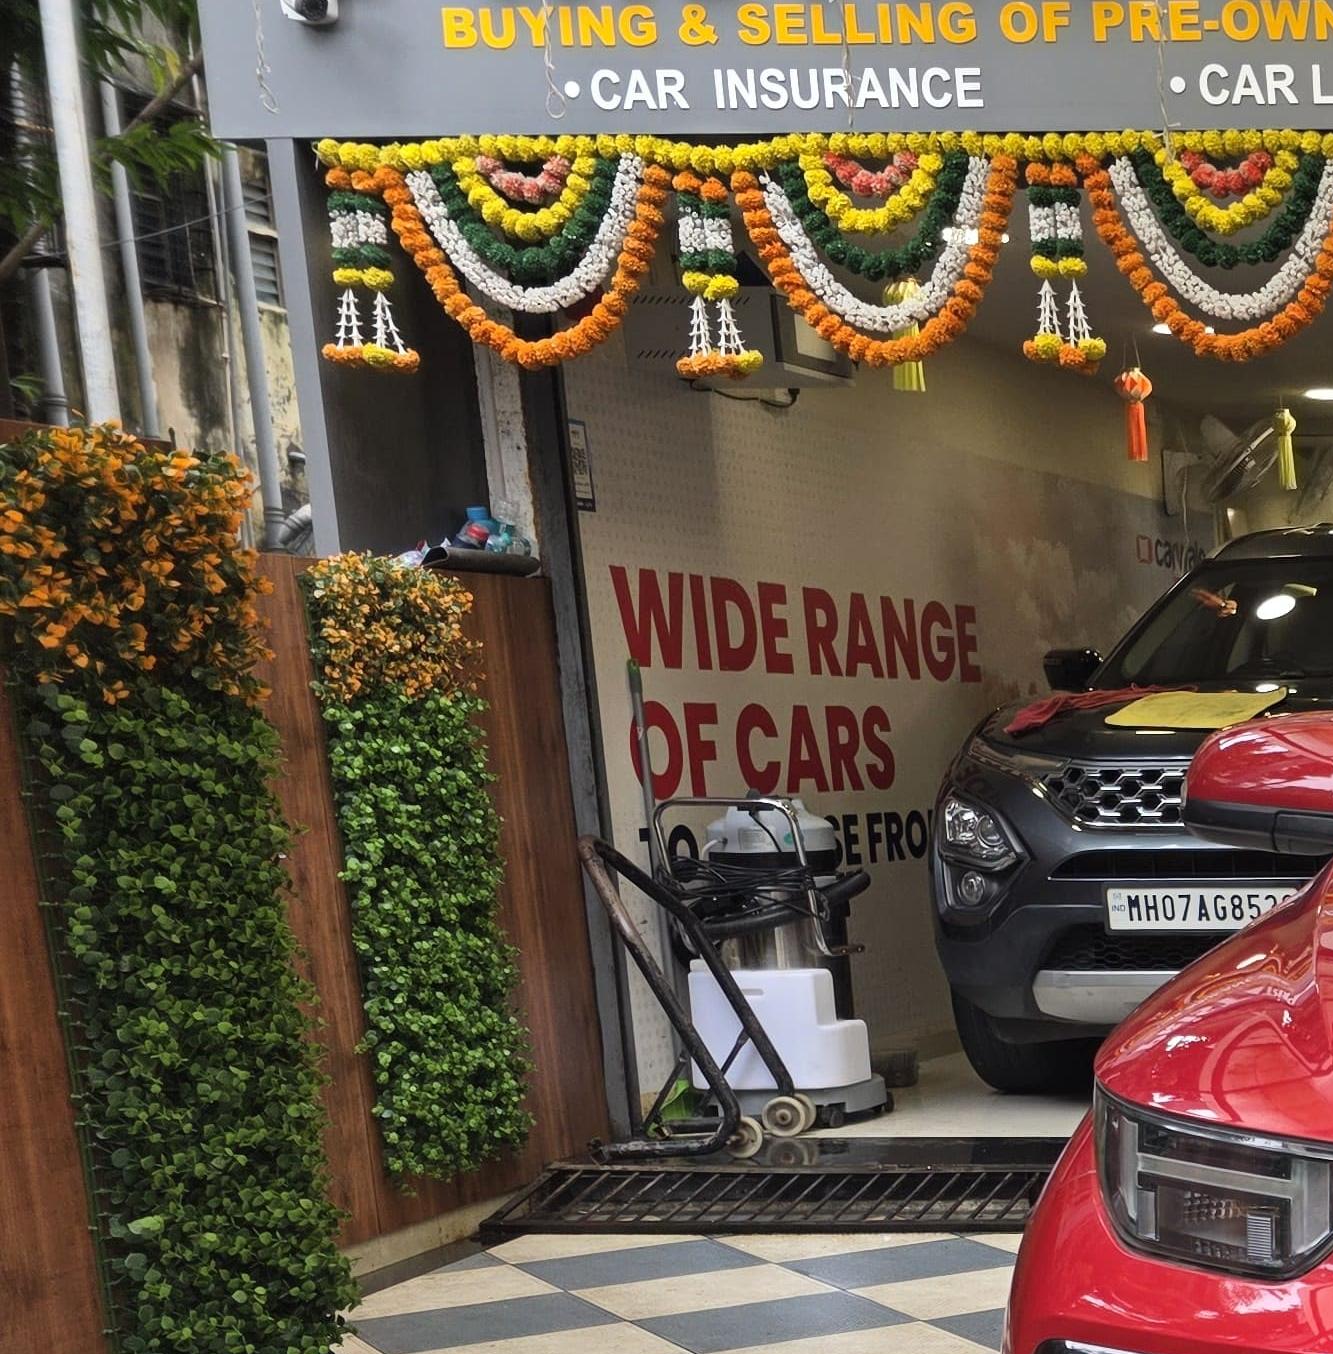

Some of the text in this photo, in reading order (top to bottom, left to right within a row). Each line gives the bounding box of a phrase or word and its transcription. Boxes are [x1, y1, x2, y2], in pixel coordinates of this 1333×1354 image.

[442, 3, 658, 49] BUYING
[679, 5, 719, 46] &
[737, 2, 977, 46] SELLING
[1000, 1, 1070, 43] OF
[591, 67, 985, 111] CAR INSURANCE
[1199, 63, 1299, 106] CAR
[609, 564, 983, 683] WIDE RANGE
[629, 700, 896, 800] OF CARS
[866, 809, 934, 864] FRO
